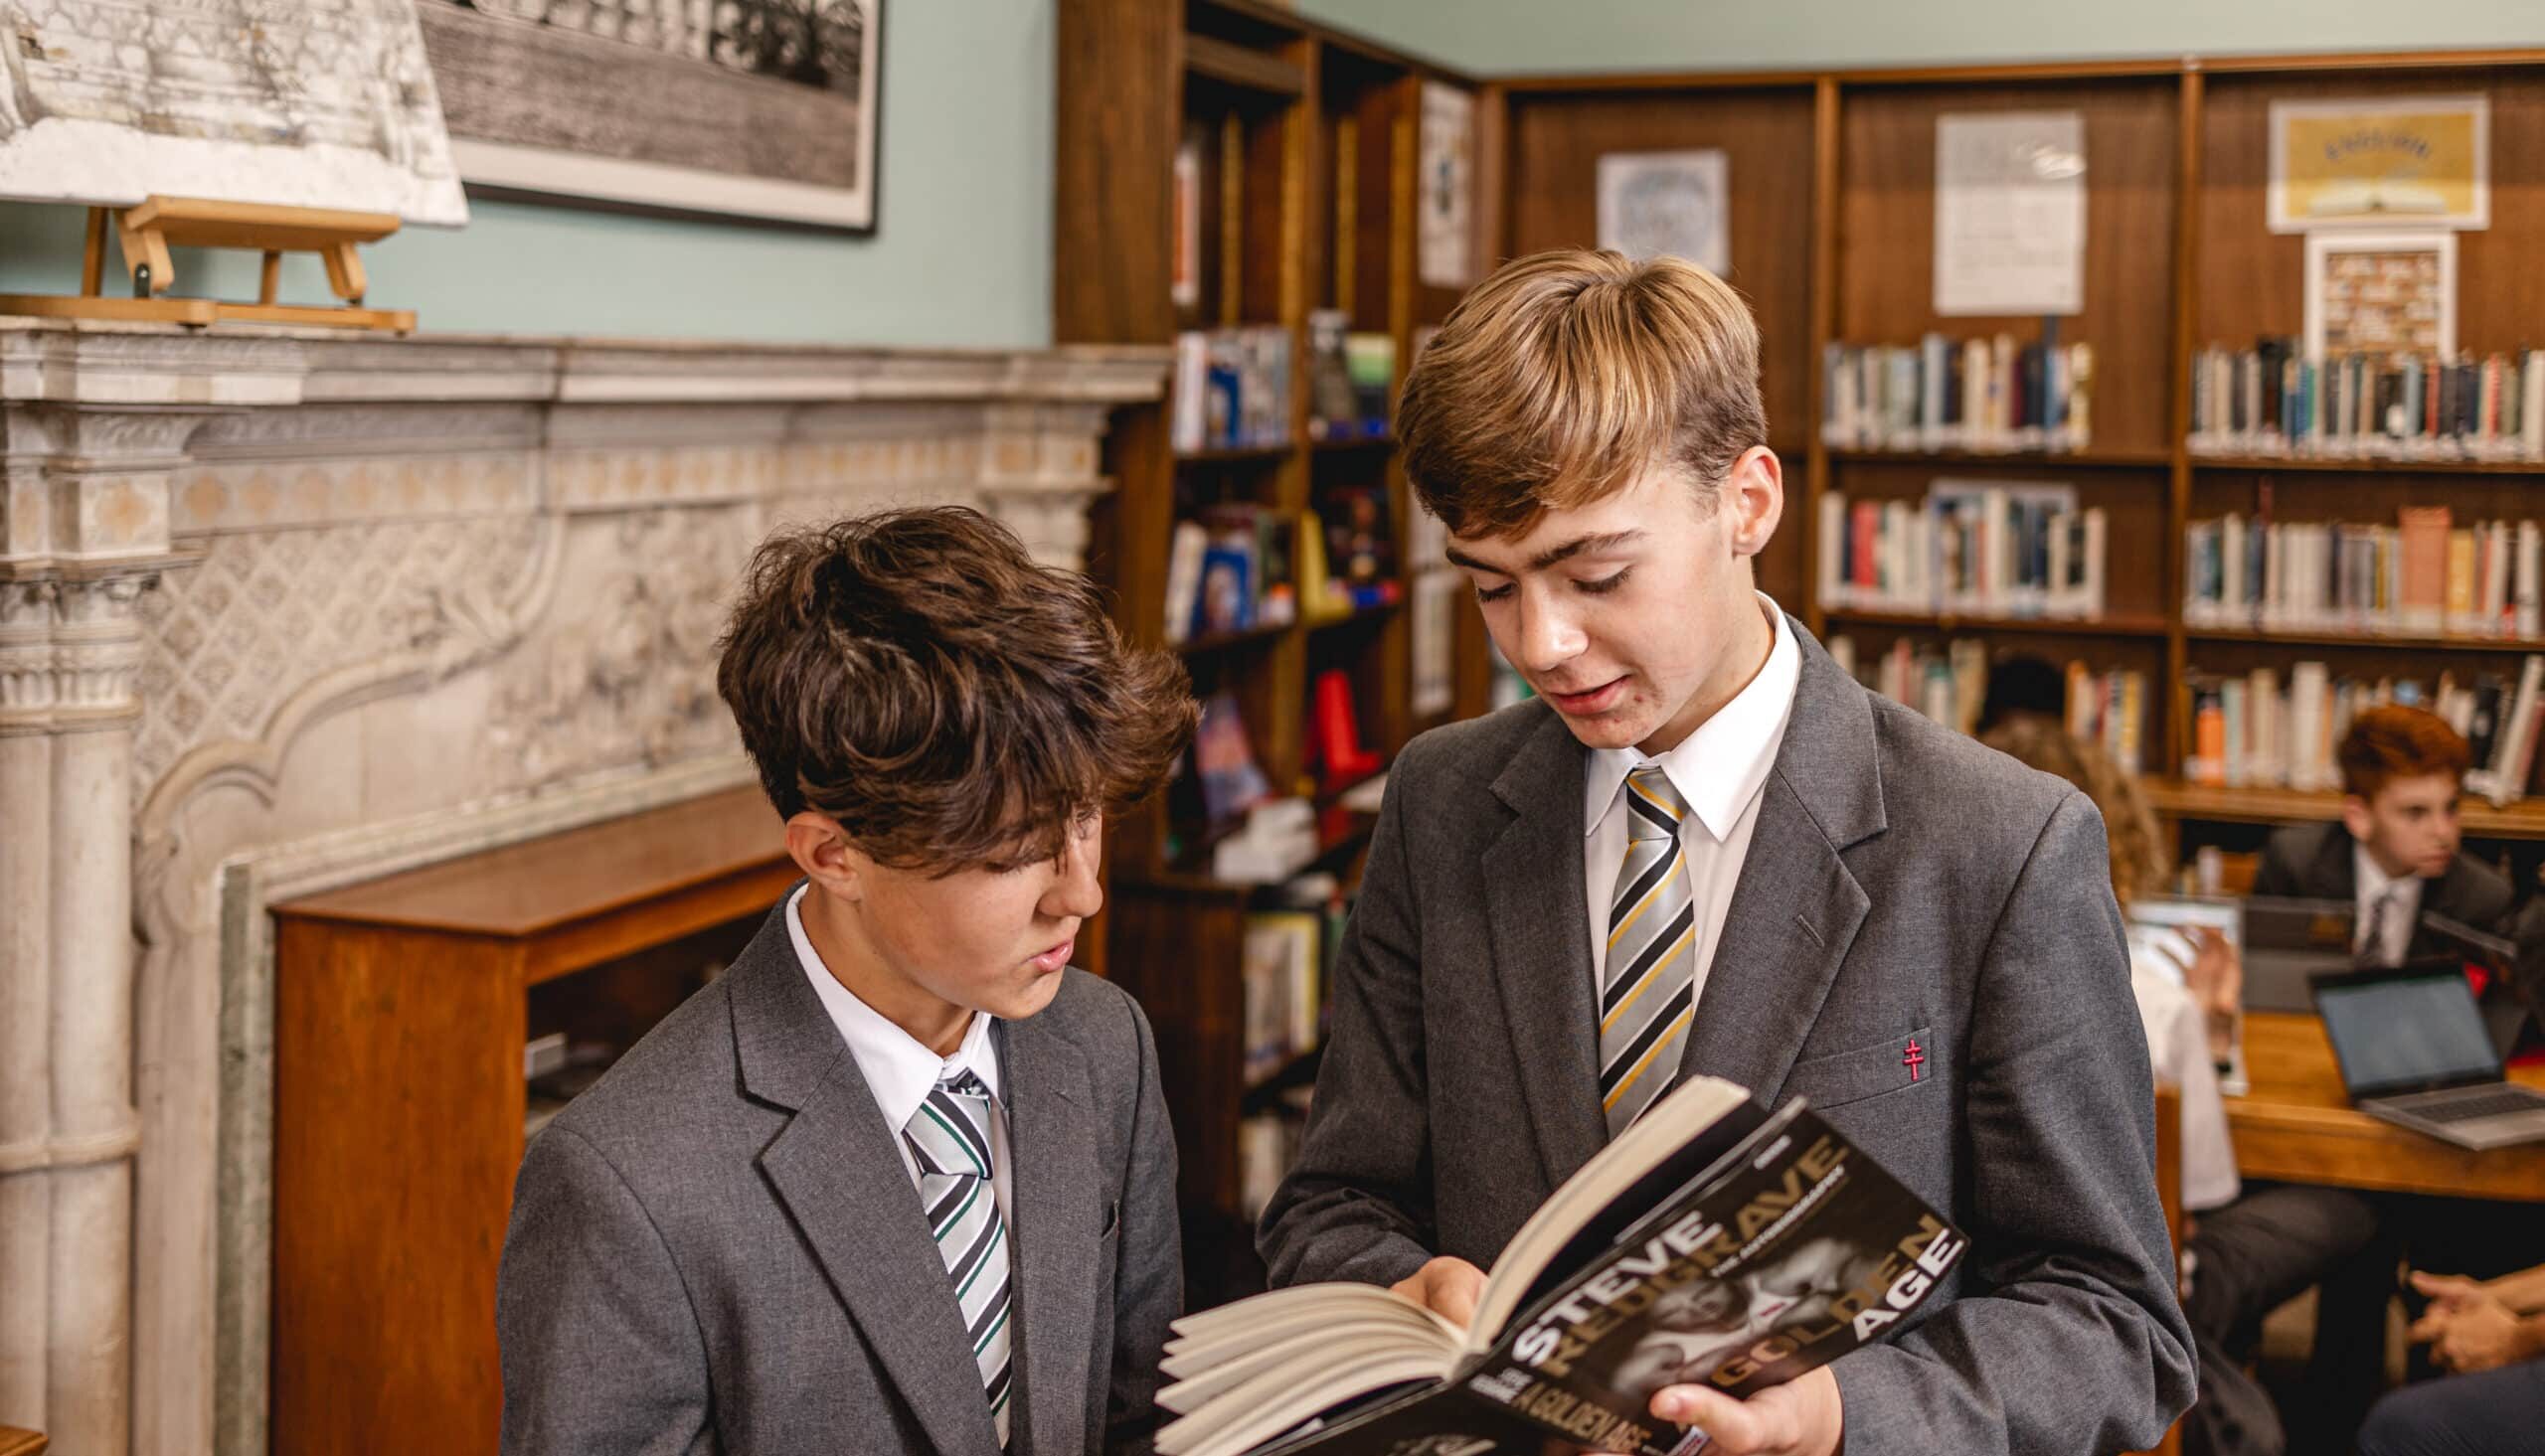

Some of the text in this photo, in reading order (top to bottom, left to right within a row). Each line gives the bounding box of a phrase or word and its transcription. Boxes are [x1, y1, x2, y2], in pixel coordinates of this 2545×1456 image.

[1512, 1210, 1724, 1368] STEVE
[1540, 1133, 1850, 1377] REDGRAVE
[1710, 1213, 1945, 1387] GOLDEN
[1852, 1227, 1965, 1342] AGE
